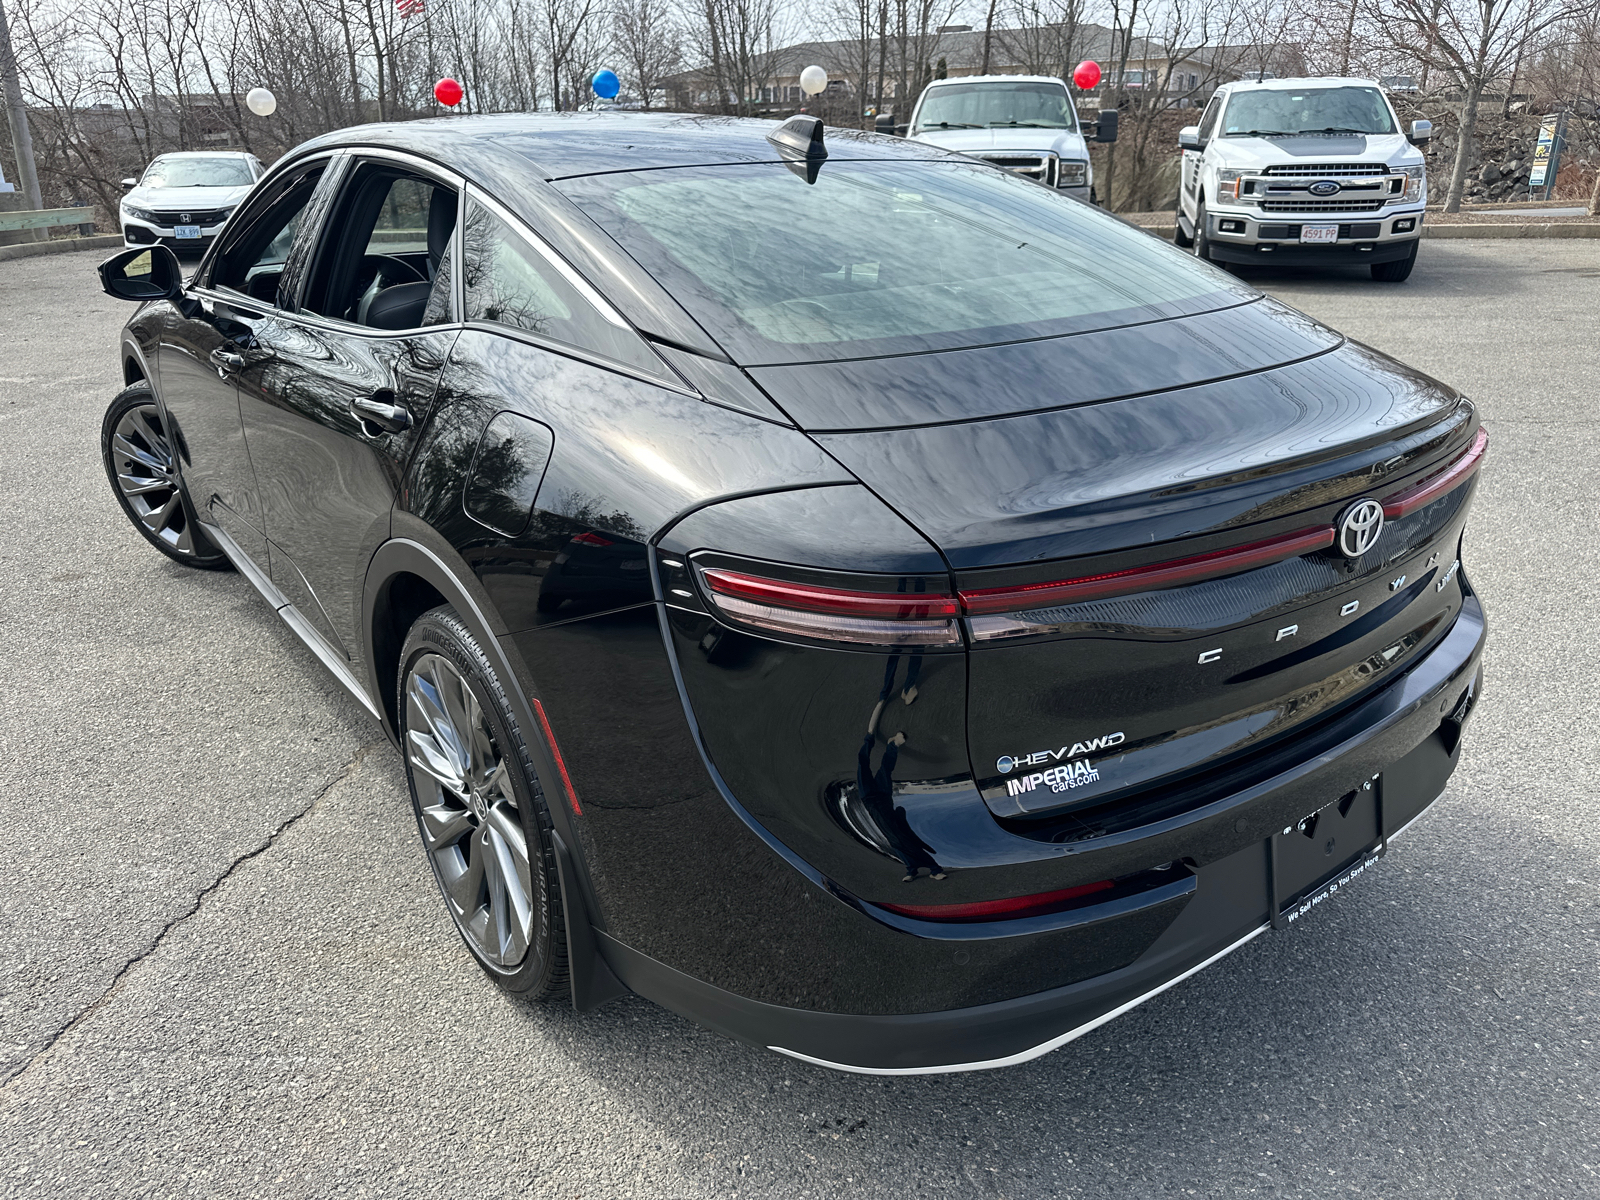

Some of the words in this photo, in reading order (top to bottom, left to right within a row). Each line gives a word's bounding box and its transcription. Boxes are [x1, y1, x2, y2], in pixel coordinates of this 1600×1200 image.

[1303, 229, 1322, 239] 4591
[1325, 229, 1336, 238] PP
[1197, 552, 1440, 665] CROWN
[422, 627, 474, 680] BRIDGESTONE
[1006, 758, 1098, 797] IMPERIAL
[1051, 771, 1100, 794] cars.com
[536, 848, 548, 938] TURANZA
[1287, 910, 1299, 923] We
[1299, 900, 1311, 916] Sell
[1312, 891, 1329, 907] More,
[1329, 884, 1338, 894] So
[1338, 875, 1350, 887] You
[1350, 864, 1364, 879] Save
[1364, 855, 1379, 868] More
